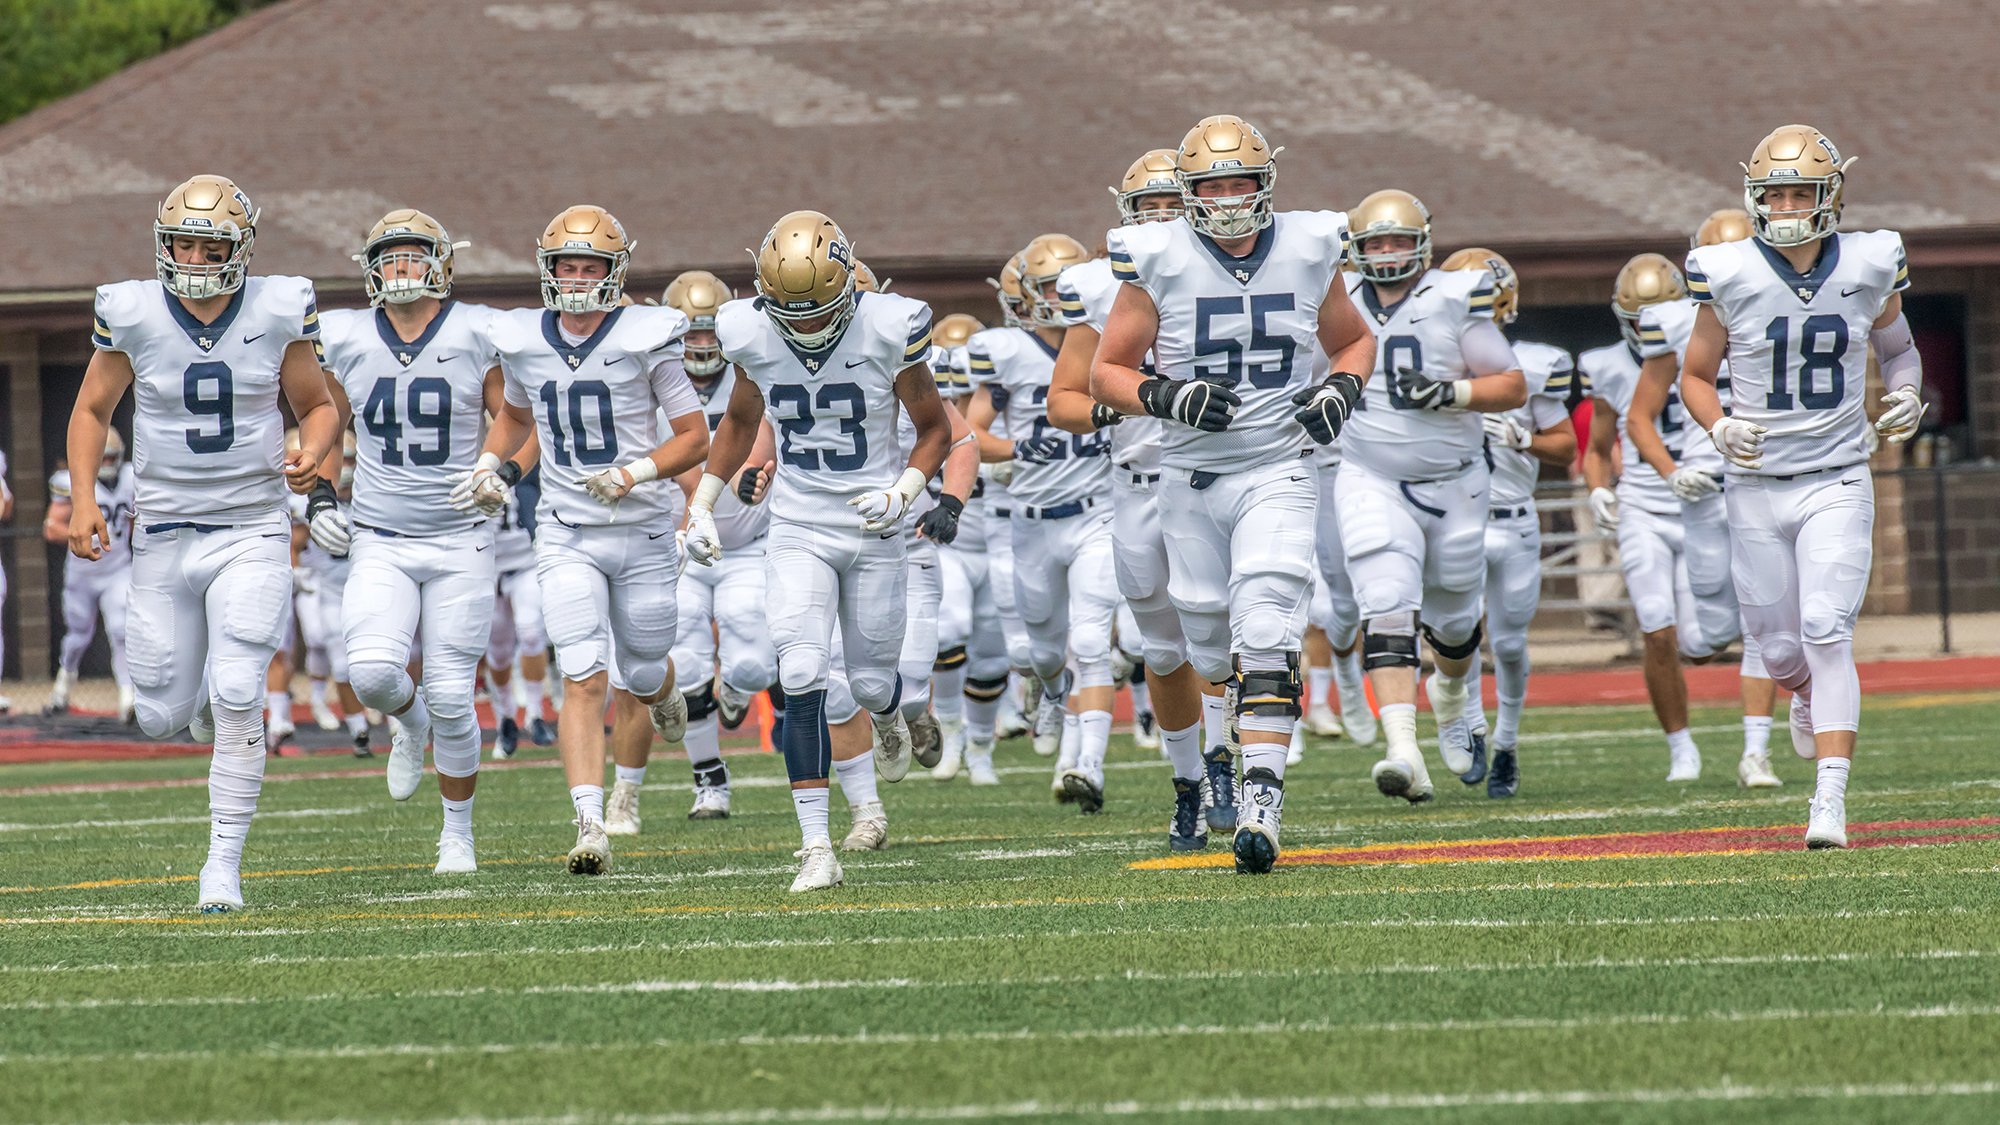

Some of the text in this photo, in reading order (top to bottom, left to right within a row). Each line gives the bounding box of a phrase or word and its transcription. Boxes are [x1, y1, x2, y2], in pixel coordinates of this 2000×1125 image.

[1235, 269, 1249, 281] BU
[1798, 287, 1812, 300] BU
[788, 301, 812, 309] BETHEL
[199, 337, 213, 349] BU
[399, 352, 412, 364] BU
[568, 355, 580, 367] BU
[1193, 293, 1296, 389] 55
[1765, 315, 1850, 410] 18
[806, 358, 819, 371] BU
[1354, 335, 1423, 411] 0
[183, 361, 235, 454] 9
[362, 376, 452, 466] 49
[539, 380, 618, 467] 10
[769, 383, 868, 472] 23
